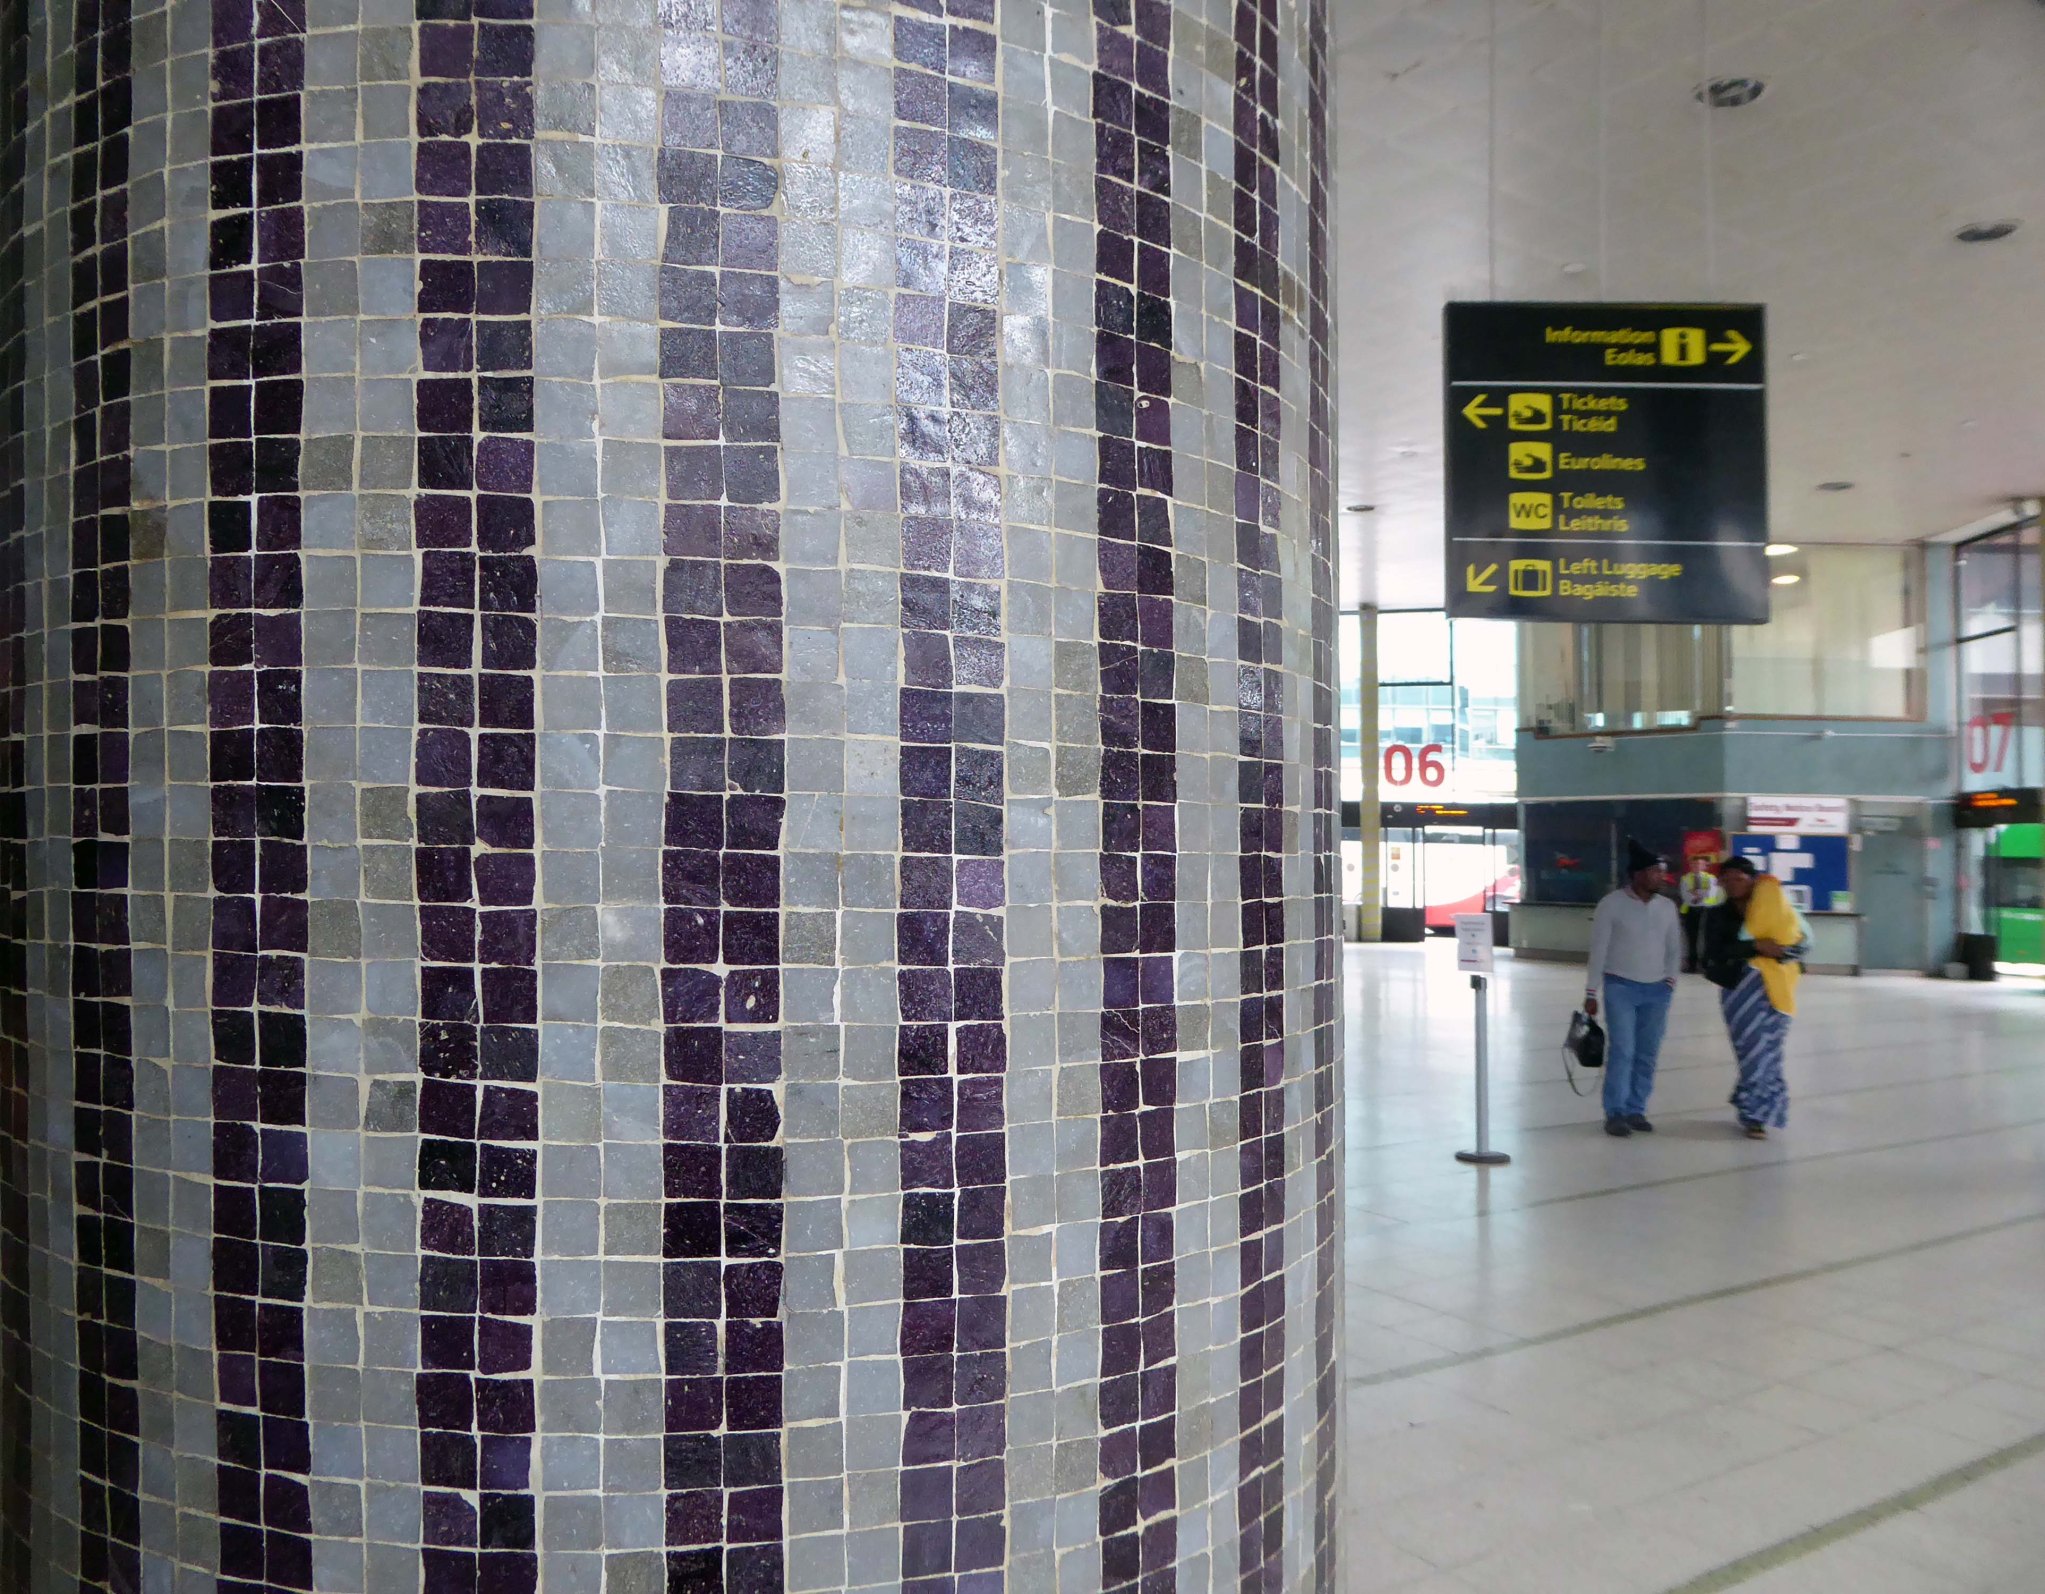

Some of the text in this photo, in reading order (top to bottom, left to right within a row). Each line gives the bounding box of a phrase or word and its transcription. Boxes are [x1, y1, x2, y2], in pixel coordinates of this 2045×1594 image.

[1546, 326, 1656, 344] Information
[1605, 348, 1656, 366] Eolas
[1559, 393, 1629, 411] Tickets
[1559, 453, 1646, 470] Eurolines
[1559, 492, 1625, 509] Toilets
[1513, 503, 1549, 518] WC
[1559, 515, 1629, 532] Leithris
[1559, 558, 1682, 580] Left Luggage
[1968, 713, 2015, 773] 07
[1384, 744, 1445, 787] 06
